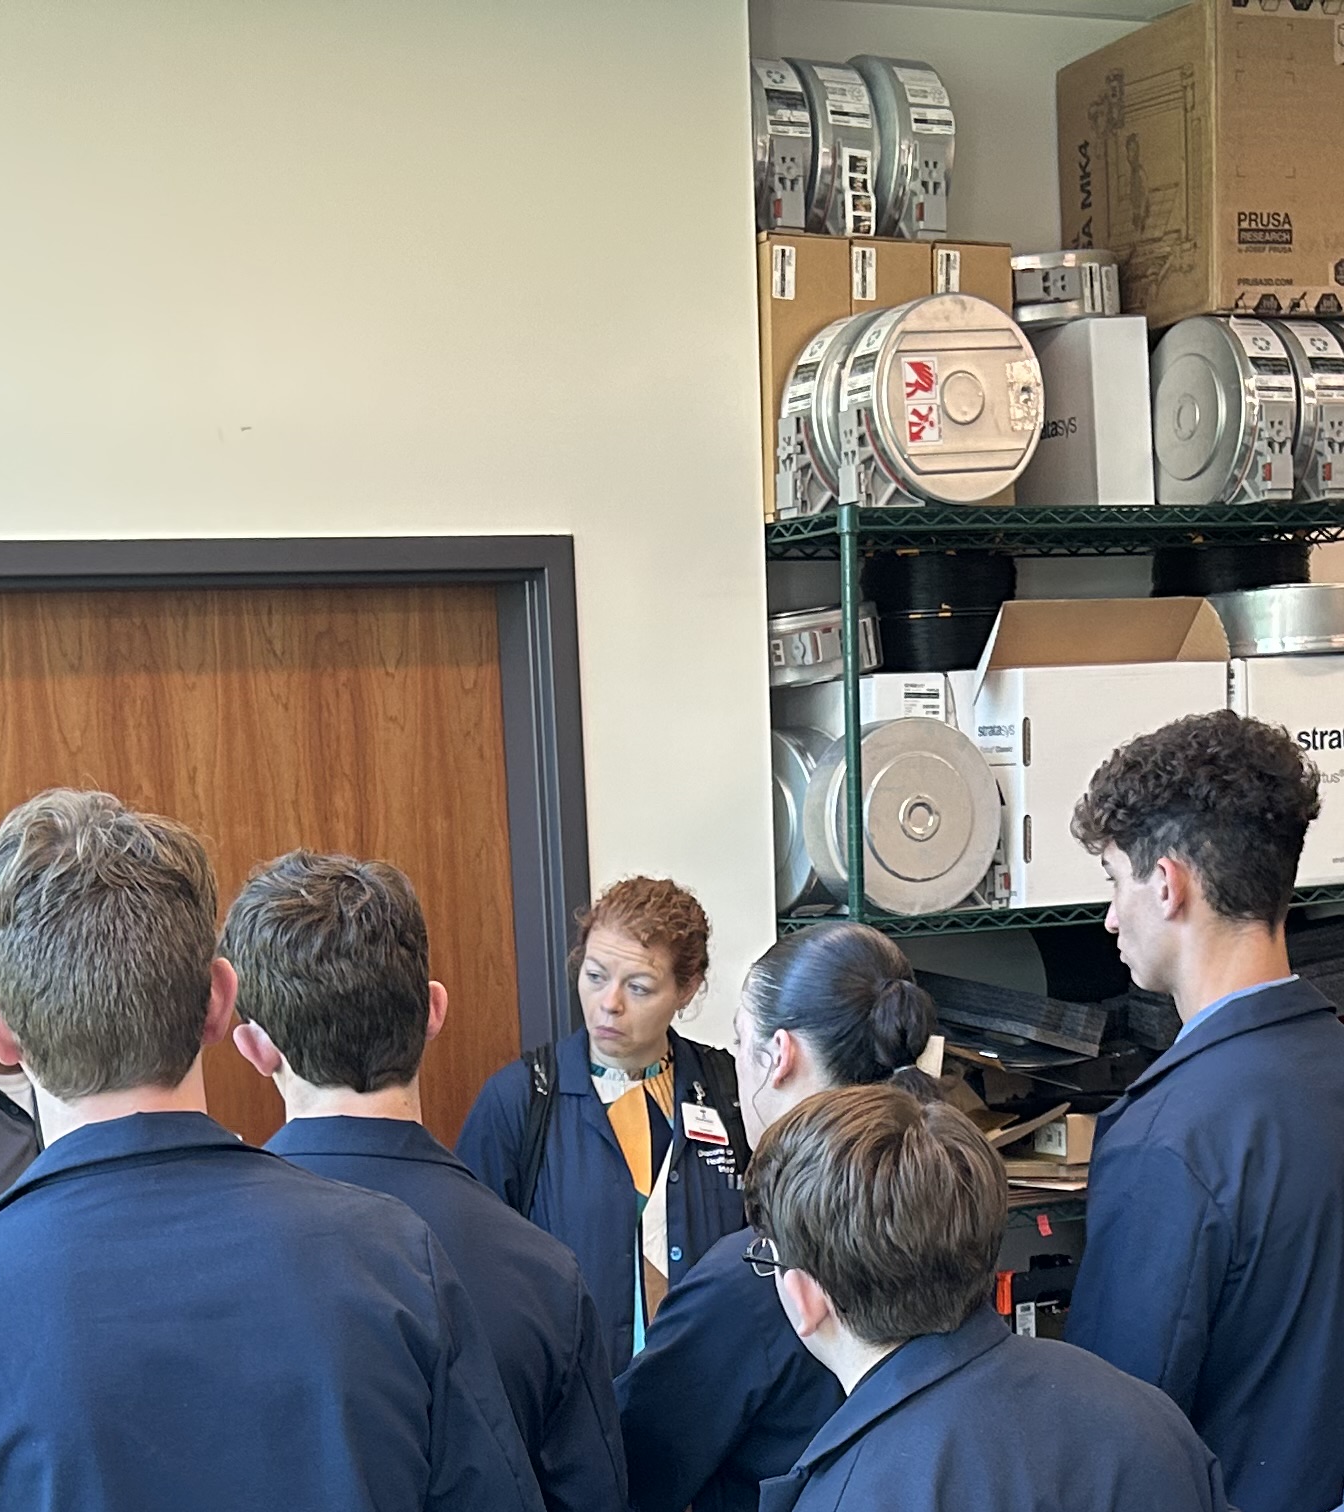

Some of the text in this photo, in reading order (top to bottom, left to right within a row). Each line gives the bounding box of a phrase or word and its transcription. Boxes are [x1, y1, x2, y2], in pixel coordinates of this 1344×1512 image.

[1237, 212, 1292, 227] PRUSA
[1240, 230, 1291, 242] RESEARCH
[1237, 278, 1293, 287] PRUSA3D.COM
[978, 725, 1016, 738] stratasys
